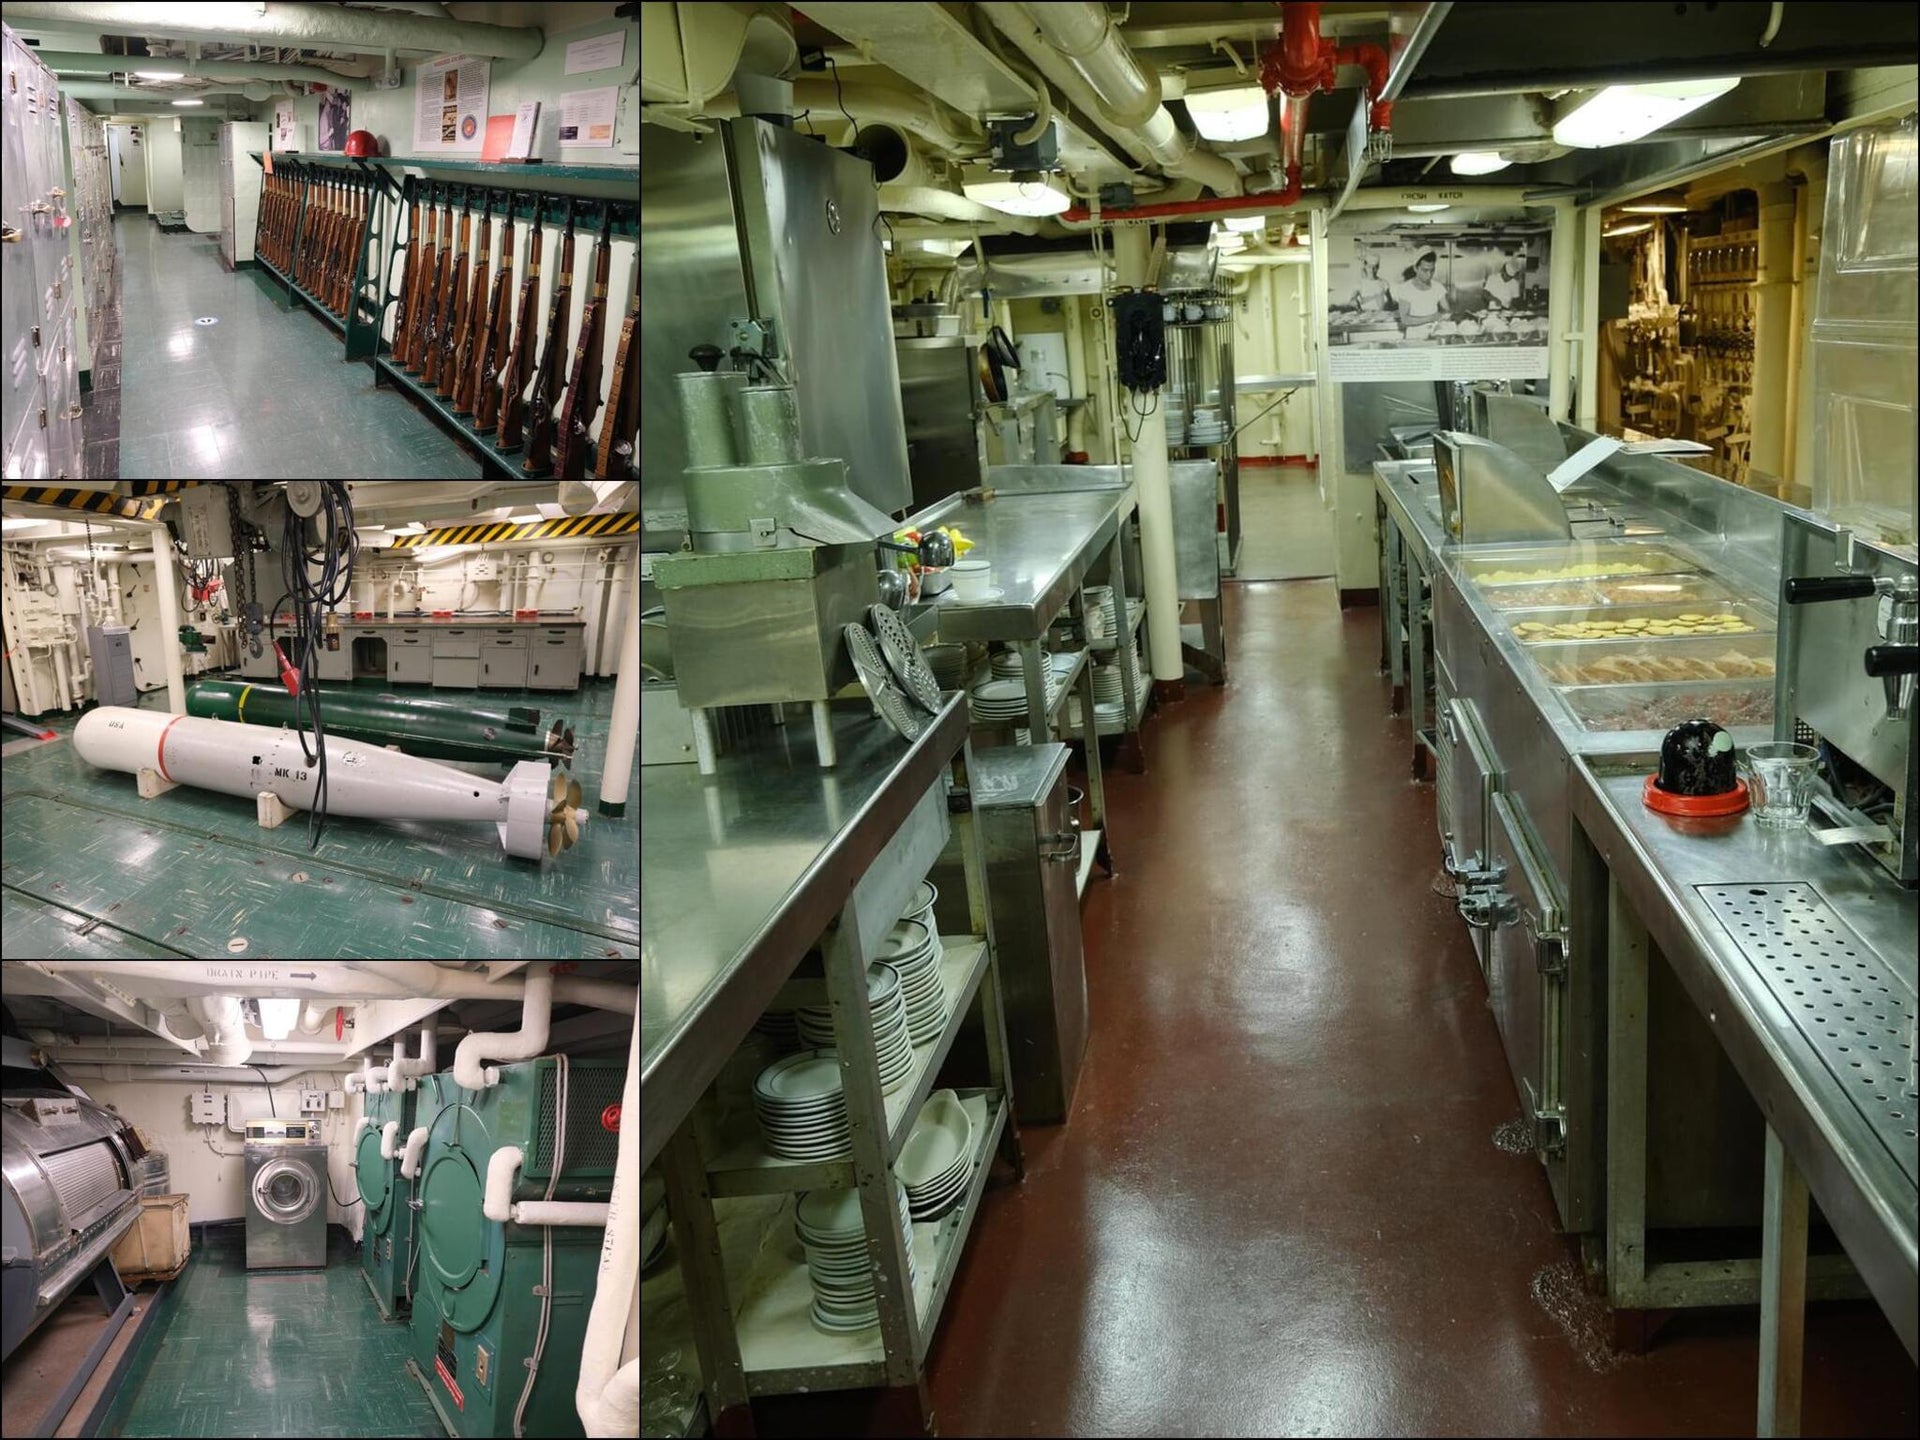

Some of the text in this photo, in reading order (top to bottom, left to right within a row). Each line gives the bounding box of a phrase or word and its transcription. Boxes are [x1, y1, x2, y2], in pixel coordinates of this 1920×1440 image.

[108, 720, 125, 730] USA
[274, 767, 307, 781] MK 13
[206, 967, 278, 980] DRAIN PIPE
